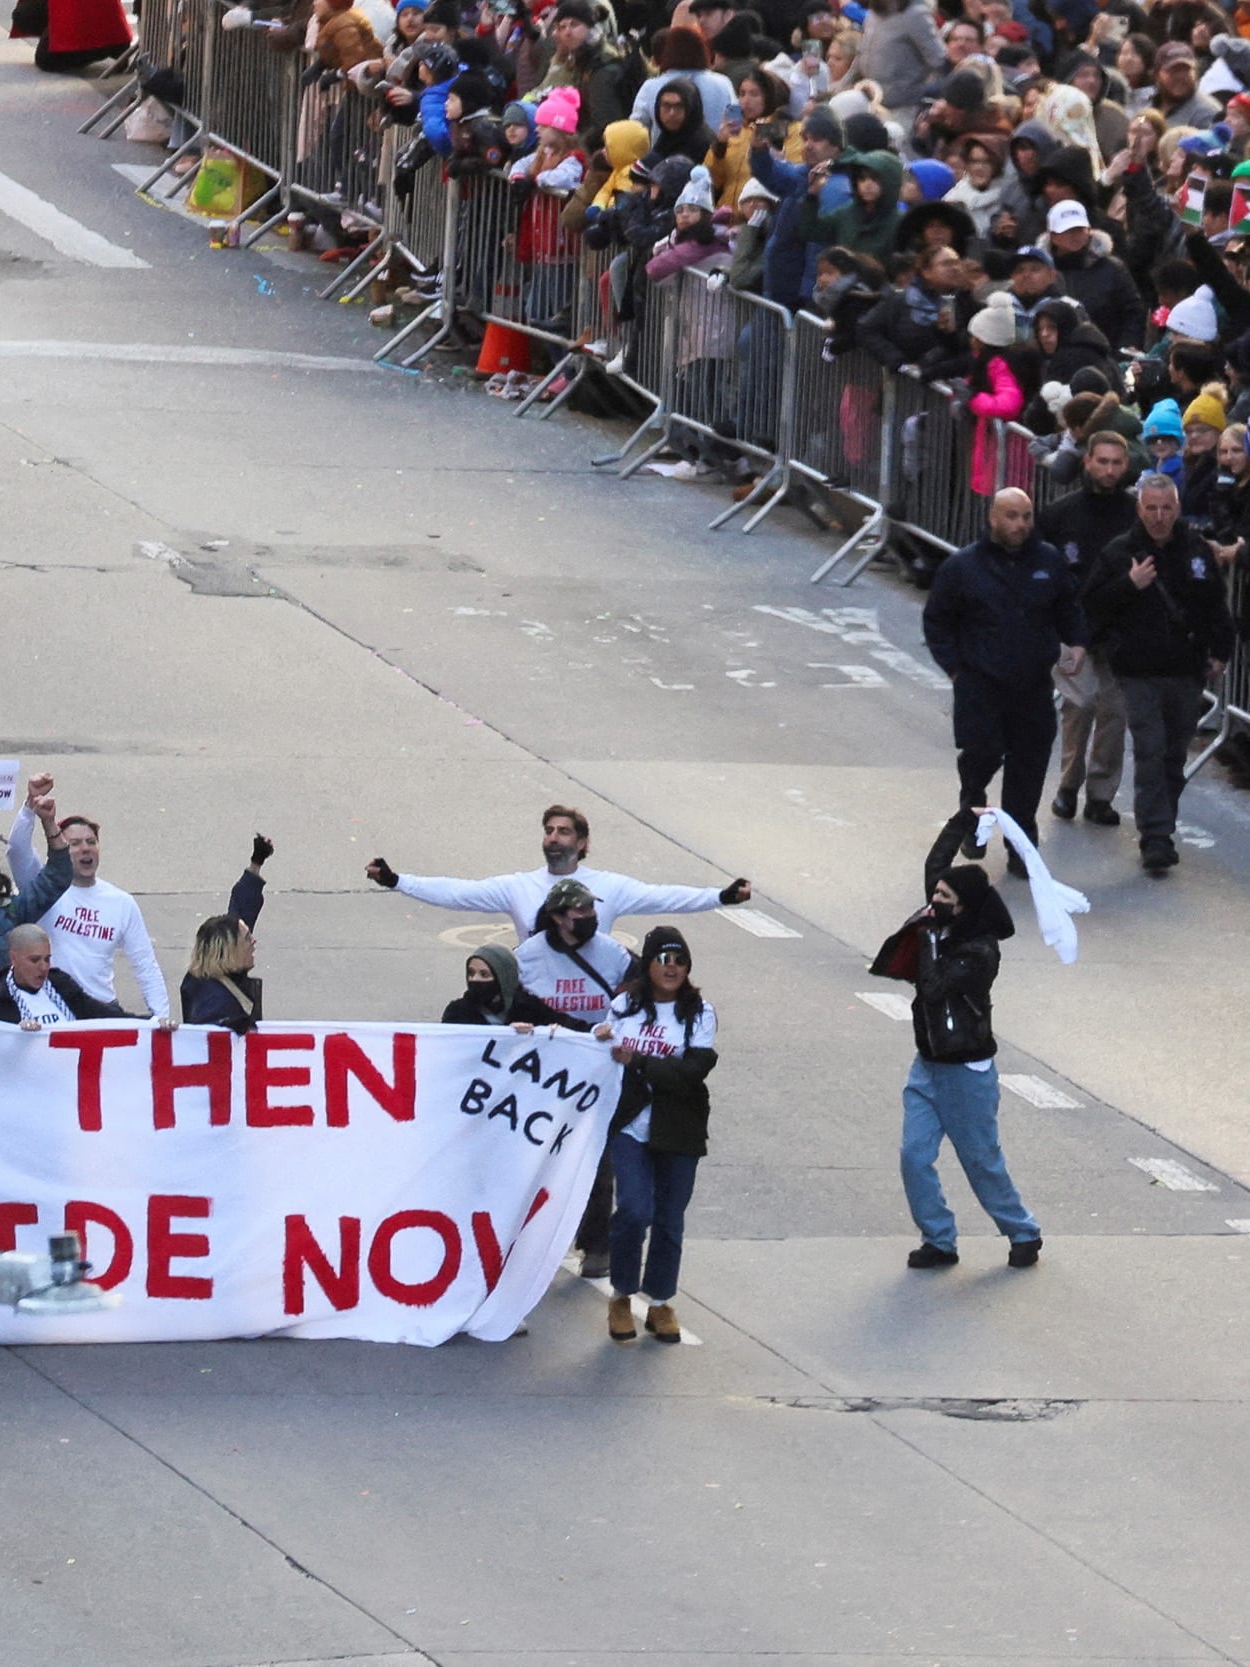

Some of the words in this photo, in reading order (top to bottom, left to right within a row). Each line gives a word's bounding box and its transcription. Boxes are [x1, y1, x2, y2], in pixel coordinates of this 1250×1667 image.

[54, 915, 116, 942] PALESTINE
[555, 978, 586, 994] FREE
[33, 1013, 60, 1024] TOP
[50, 1031, 416, 1130] THEN
[481, 1038, 601, 1113] LAND
[460, 1078, 574, 1155] BACK
